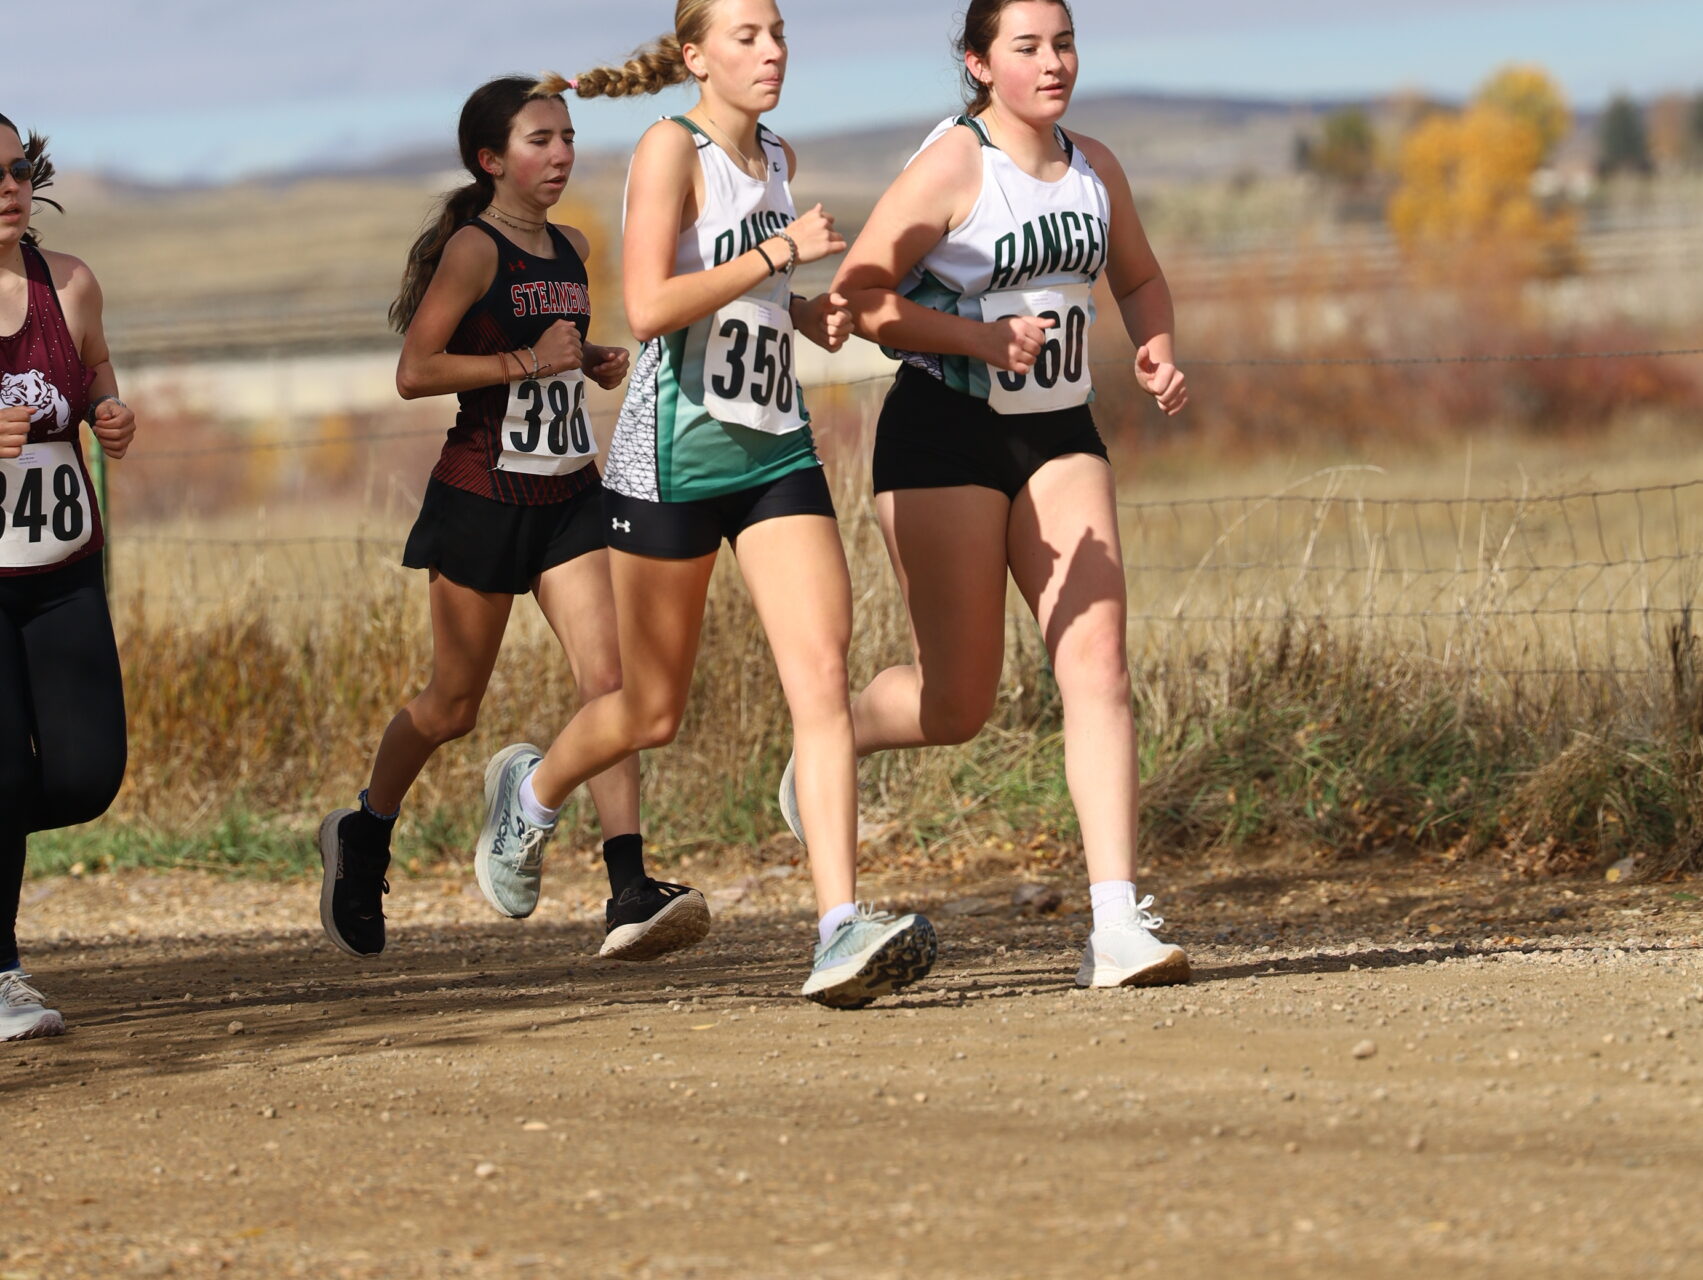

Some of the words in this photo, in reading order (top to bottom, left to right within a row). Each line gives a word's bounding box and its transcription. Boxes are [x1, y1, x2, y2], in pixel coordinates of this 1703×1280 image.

[511, 281, 591, 317] STEAMBO
[711, 318, 793, 413] 358
[509, 380, 590, 455] 386
[0, 463, 83, 543] 48
[491, 809, 510, 855] HOKA
